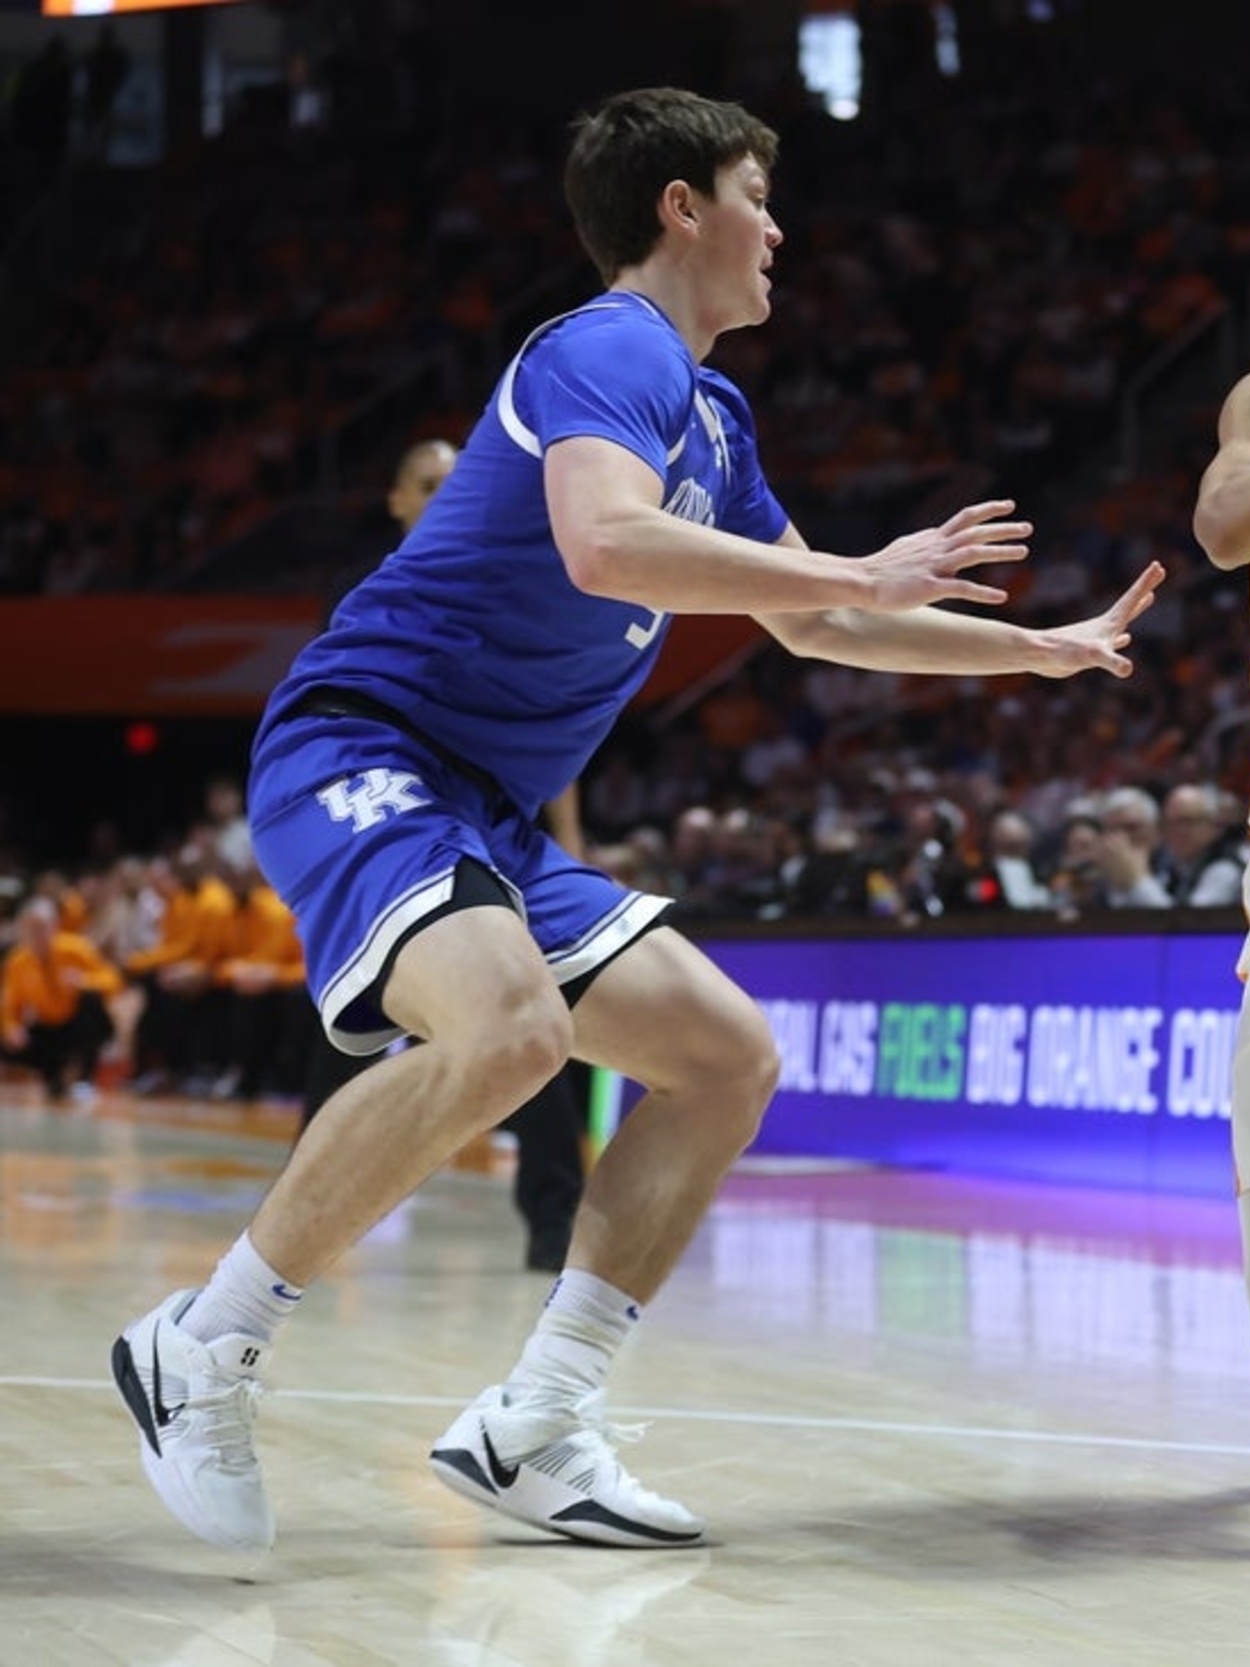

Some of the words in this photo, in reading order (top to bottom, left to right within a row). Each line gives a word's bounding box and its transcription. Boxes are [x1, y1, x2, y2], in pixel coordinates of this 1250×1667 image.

[315, 767, 433, 834] UK
[966, 1004, 1027, 1105] BIG
[1027, 1005, 1162, 1114] ORANGE
